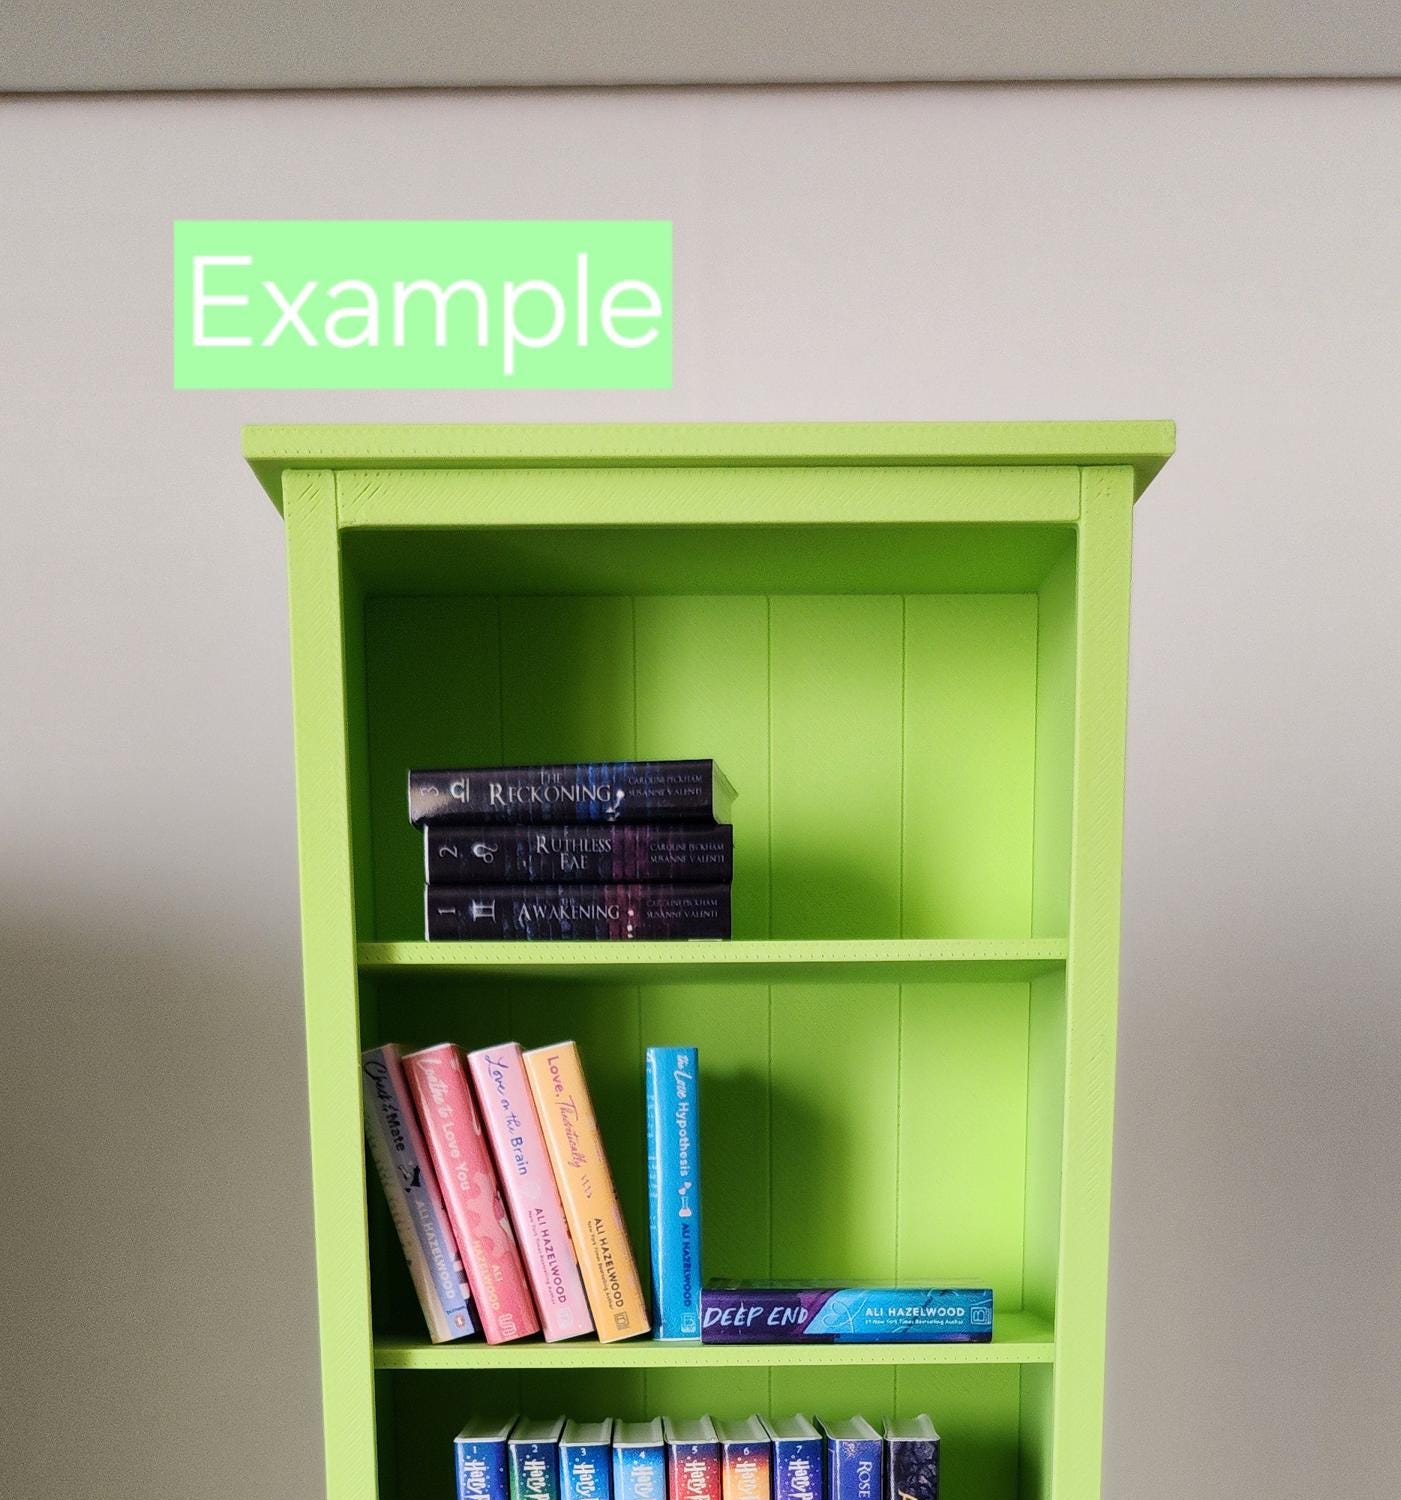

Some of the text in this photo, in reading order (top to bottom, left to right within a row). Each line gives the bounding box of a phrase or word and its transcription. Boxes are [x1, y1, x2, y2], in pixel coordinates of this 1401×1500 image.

[420, 785, 439, 797] 3
[538, 771, 561, 785] THE
[489, 782, 611, 806] RECKONING
[439, 845, 458, 858] 2
[536, 834, 612, 855] RUTHLESS
[560, 853, 587, 871] FAE
[518, 902, 620, 922] AWAKENING
[546, 1055, 564, 1098] Love,
[484, 1054, 510, 1096] Love
[501, 1098, 511, 1111] on
[510, 1136, 529, 1176] Brain
[385, 1112, 406, 1152] Mate
[675, 1102, 691, 1177] Hypothesis
[443, 1121, 460, 1159] Love
[455, 1161, 471, 1191] You
[681, 1223, 690, 1239] ALI
[415, 1201, 456, 1299] ALI HAZELWOOD
[535, 1207, 547, 1226] ALI
[541, 1229, 567, 1304] HAZELWOOD
[594, 1218, 606, 1235] ALI
[600, 1237, 625, 1308] HAZELWOOD
[682, 1241, 692, 1308] HAZELWOOD
[703, 1304, 763, 1329] DEEP
[767, 1305, 809, 1327] END
[865, 1307, 883, 1317] ALI
[888, 1306, 966, 1317] HAZELWOOD
[472, 1446, 477, 1454] 1
[531, 1444, 538, 1453] 2
[580, 1447, 587, 1456] 3
[639, 1450, 646, 1459] 4
[691, 1445, 698, 1454] 5
[743, 1446, 750, 1456] 6
[795, 1445, 802, 1454] 7
[463, 1459, 487, 1495] Harry
[523, 1458, 546, 1493] Harry
[573, 1461, 596, 1497] Harry
[630, 1464, 654, 1499] Harry
[683, 1459, 706, 1495] Harry
[735, 1460, 758, 1494] Harry
[788, 1458, 810, 1493] Harry
[856, 1461, 873, 1498] ROSE
